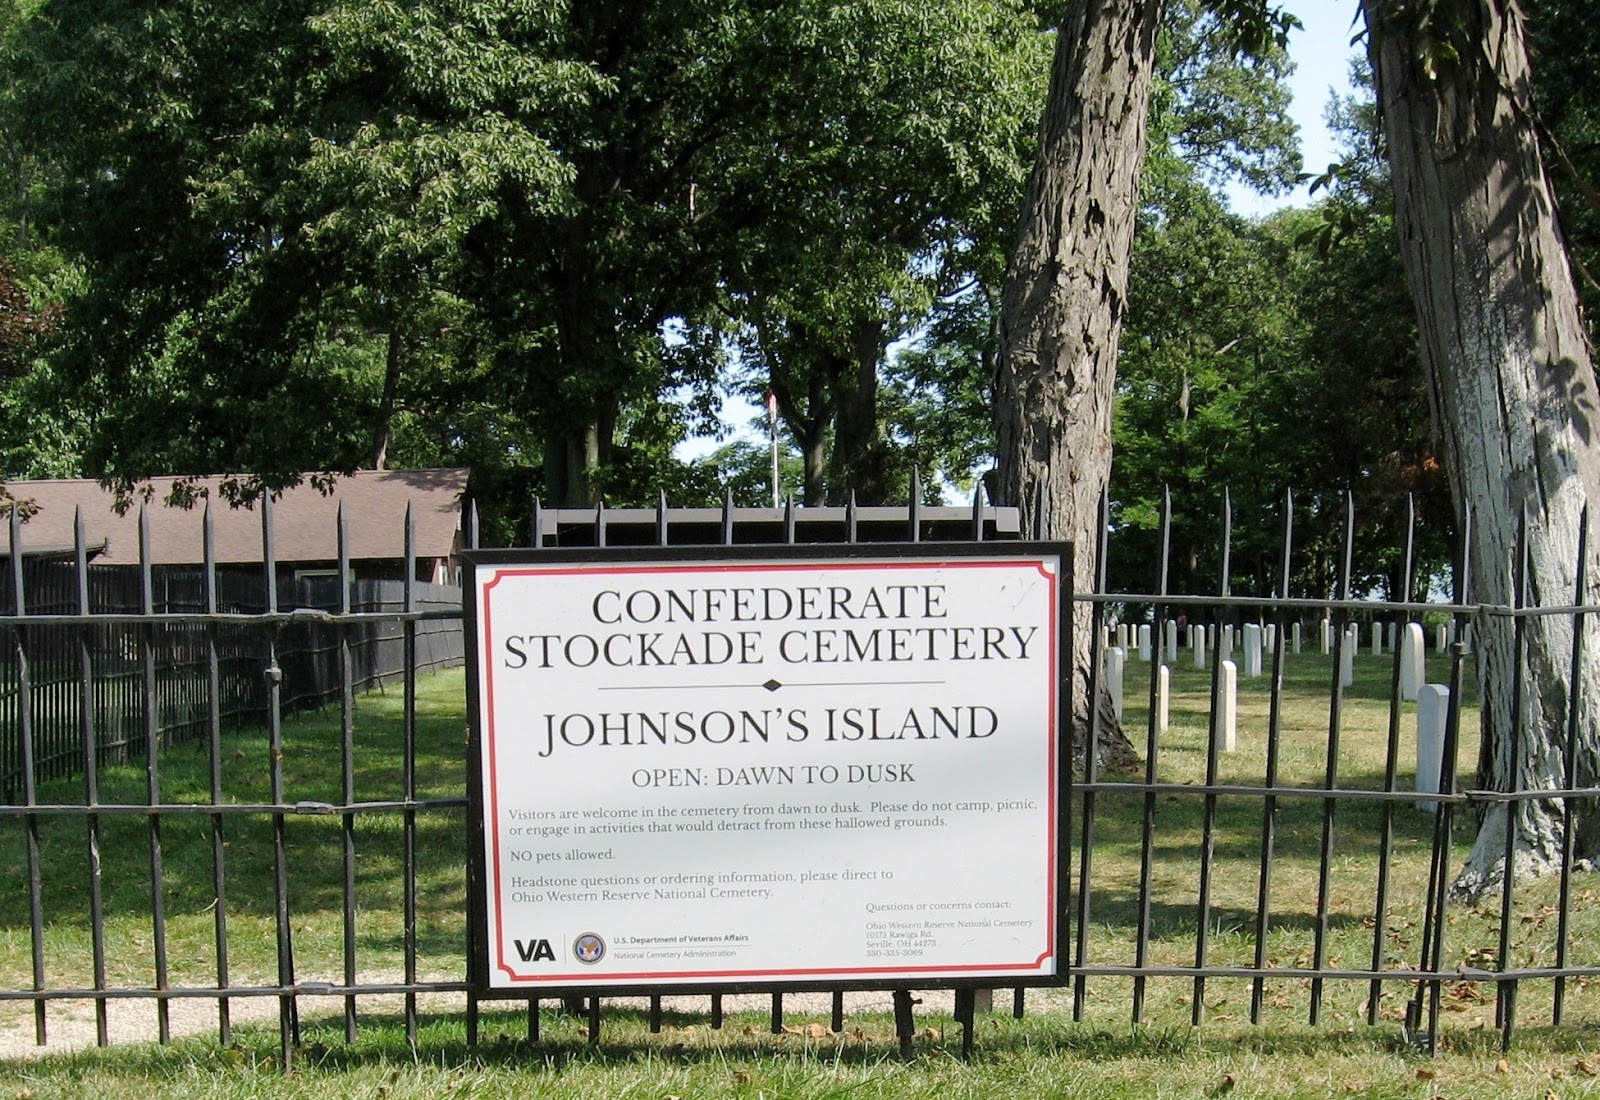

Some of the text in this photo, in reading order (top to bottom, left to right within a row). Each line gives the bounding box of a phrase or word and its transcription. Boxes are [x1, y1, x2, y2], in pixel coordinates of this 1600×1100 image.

[593, 585, 947, 624] CONFEDERATE
[505, 627, 1038, 669] STOCKADE CEMETERY
[538, 706, 998, 757] JOHNSON'S ISLAND
[632, 764, 915, 788] OPEN: DAWN TO DUSK
[508, 799, 1037, 820] Visitors are welcome in the cemetery from dawn to dusk. Please do not camp, picnic,
[509, 816, 947, 838] or engage in activities that would detract from these hallowed grounds.
[511, 848, 615, 864] NO pets allowed.
[512, 869, 893, 888] Headstone questions or ordering information, please direct to
[512, 886, 773, 903] Ohio Western Reserve National Cemetery.
[866, 903, 914, 912] Questions
[929, 902, 972, 910] concerns
[866, 922, 886, 930] Ohio
[994, 920, 1032, 928] Cemetery
[630, 936, 677, 944] Department
[724, 934, 748, 942] Affairs
[514, 939, 556, 962] VA
[647, 951, 681, 959] Cemetery
[683, 949, 736, 958] Administration
